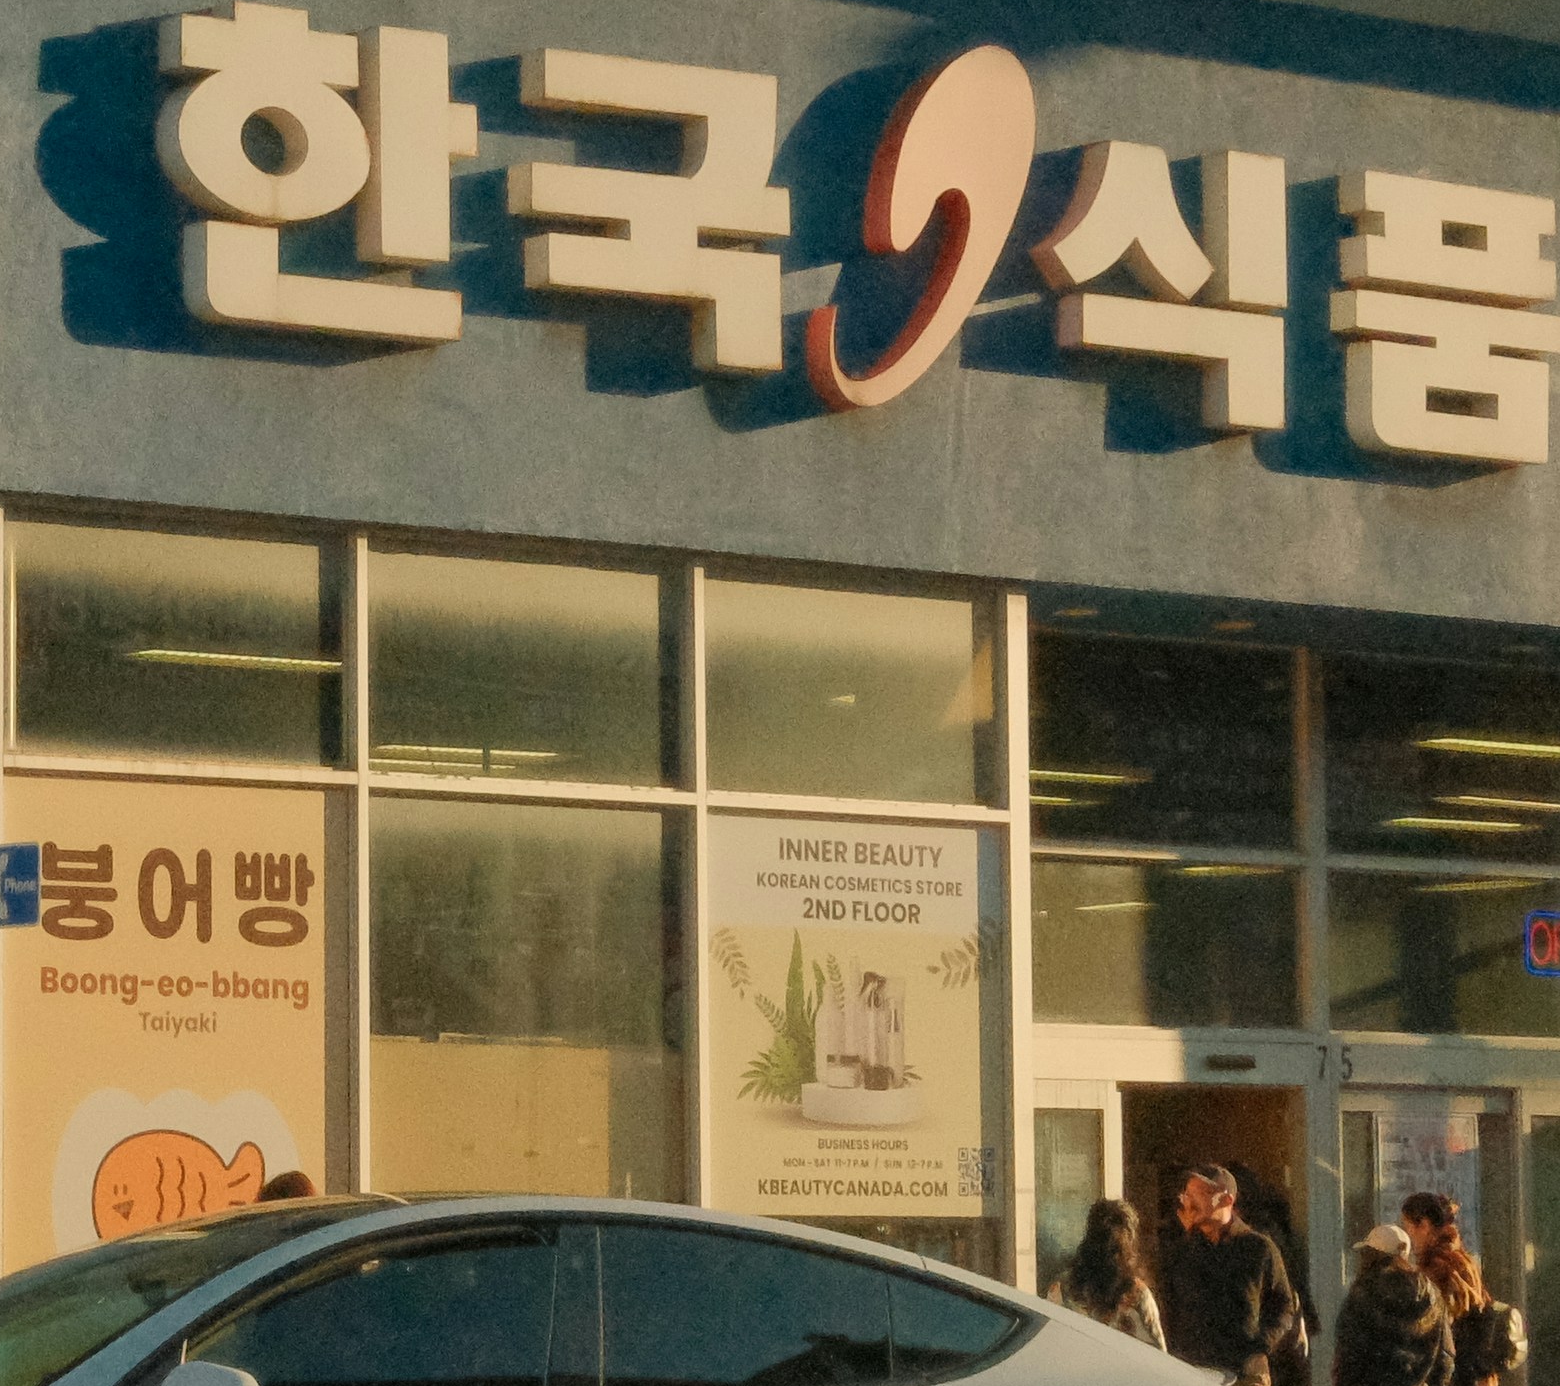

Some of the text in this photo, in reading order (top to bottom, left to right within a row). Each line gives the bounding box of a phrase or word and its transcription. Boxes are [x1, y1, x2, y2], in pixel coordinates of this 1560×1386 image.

[156, 0, 791, 374] 한국
[779, 836, 944, 869] INNER BEAUTY
[40, 840, 316, 948] 붕어빵
[756, 871, 964, 898] KOREAN COSMETICS STORE
[802, 896, 921, 925] 2ND FLOOR
[39, 966, 310, 1011] Boong-eo-bbang
[138, 1011, 218, 1039] Taiyaki
[817, 1138, 909, 1152] BUSINESS HOURS
[757, 1179, 948, 1197] KBEAUTYCANADA.COM
